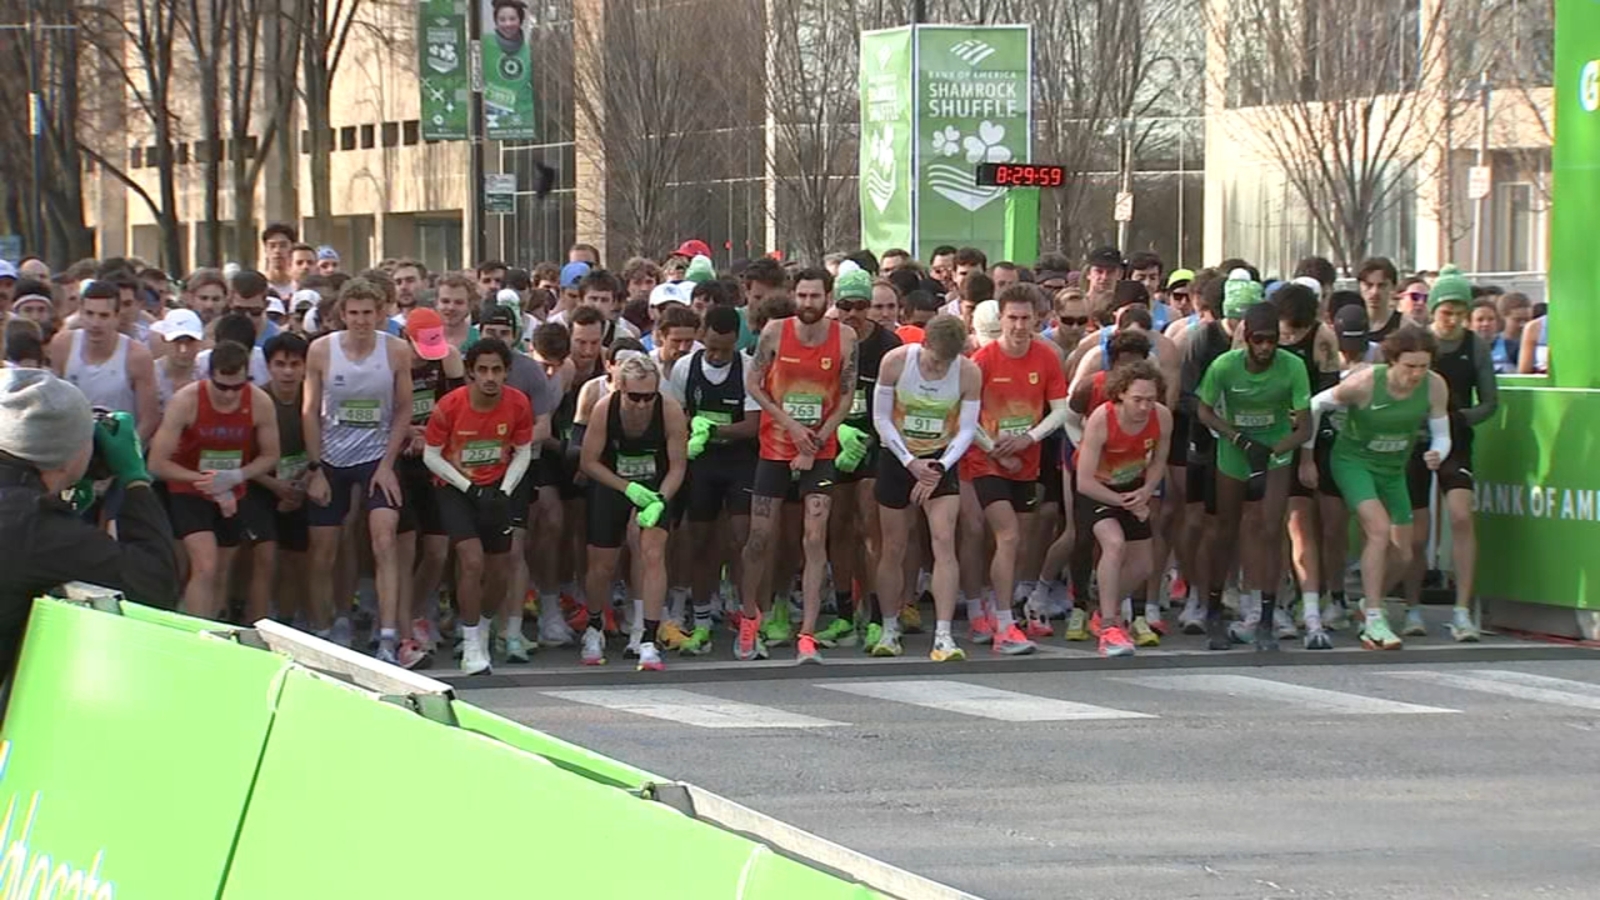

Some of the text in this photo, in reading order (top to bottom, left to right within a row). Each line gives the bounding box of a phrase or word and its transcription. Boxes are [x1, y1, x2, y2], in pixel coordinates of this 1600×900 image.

[928, 71, 1017, 80] BANK OF AMERICA
[929, 82, 1017, 98] SHAMROCK
[928, 99, 1018, 118] SHUFFLE
[996, 166, 1062, 186] 8:29:59
[345, 409, 374, 421] 488
[787, 404, 815, 417] 263
[914, 418, 932, 430] 91
[467, 449, 497, 461] 257
[1531, 485, 1557, 518] OF
[1561, 488, 1600, 521] AM
